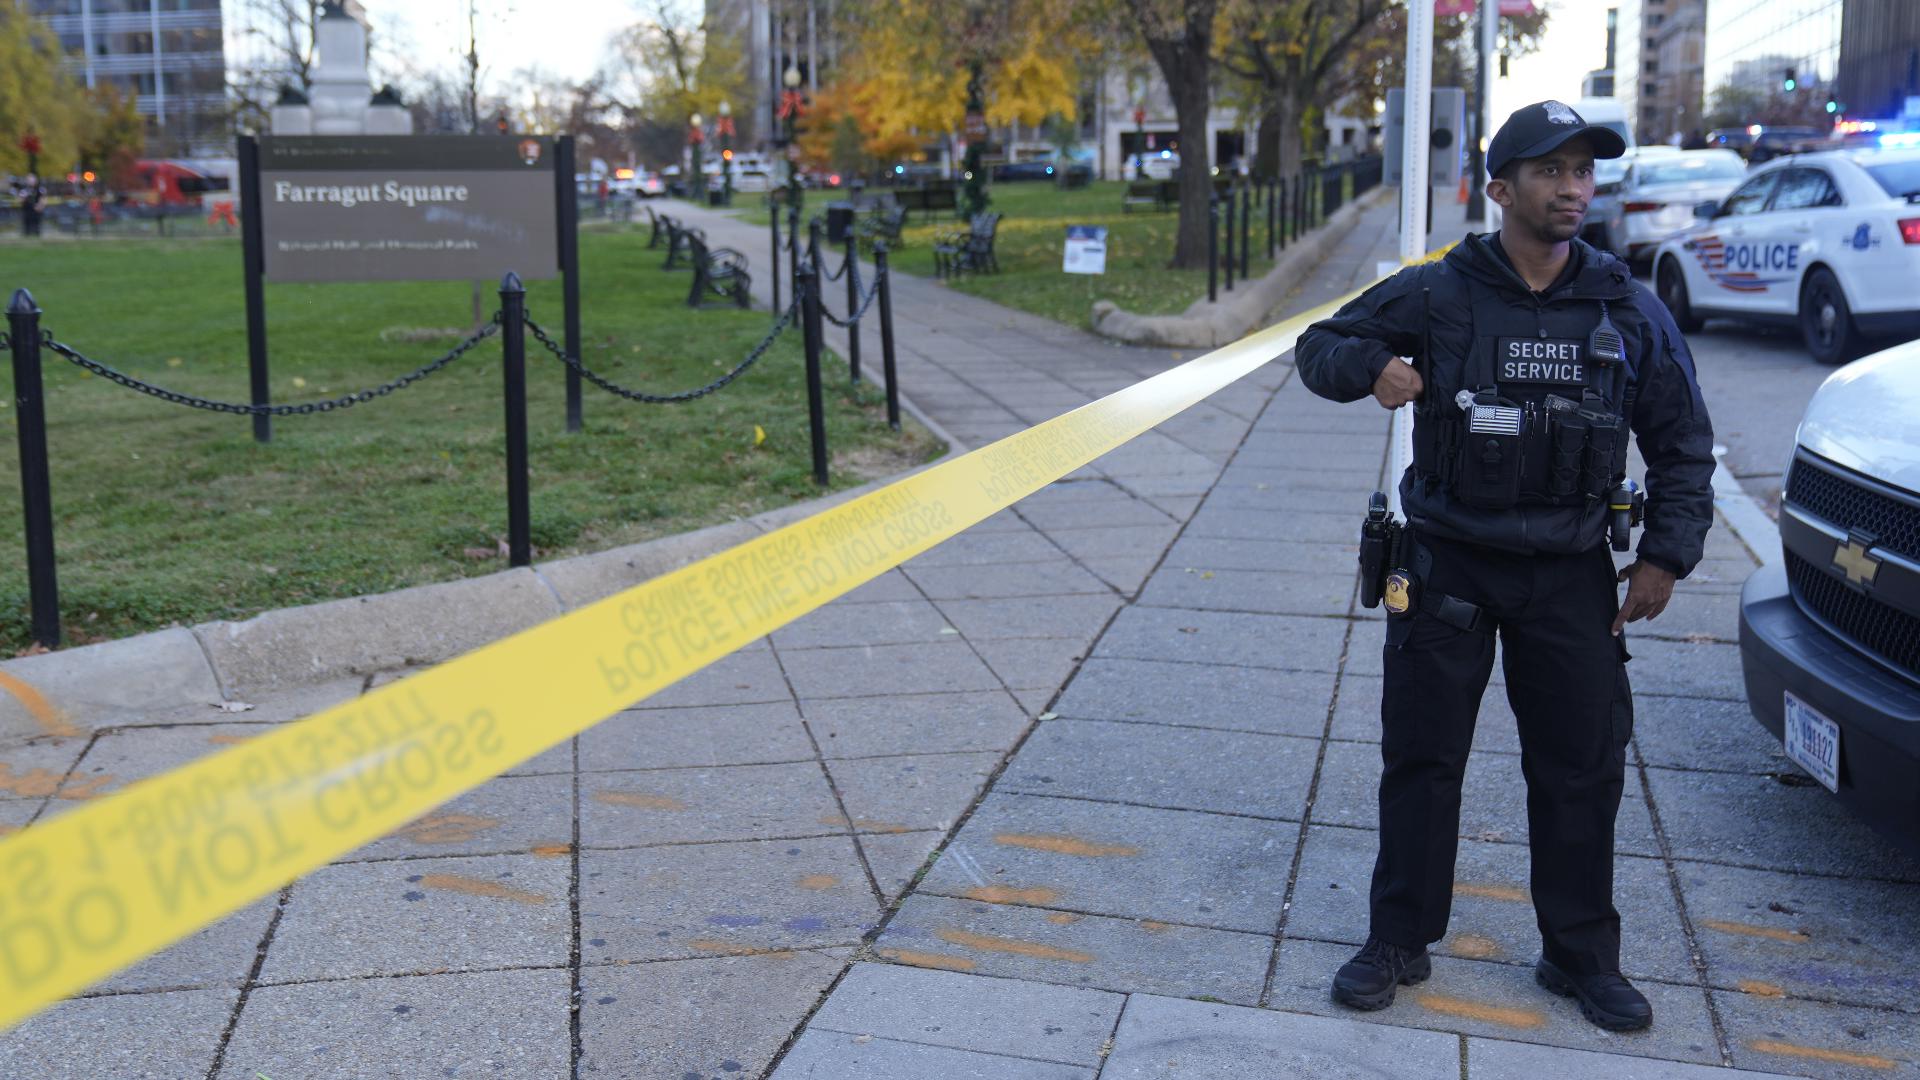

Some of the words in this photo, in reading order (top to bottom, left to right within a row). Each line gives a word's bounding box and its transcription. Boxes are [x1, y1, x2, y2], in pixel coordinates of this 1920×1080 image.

[274, 181, 380, 207] Farragut
[383, 180, 469, 206] Square
[1725, 245, 1799, 270] POLICE
[1508, 342, 1580, 360] SECRET
[1504, 362, 1583, 381] SERVICE
